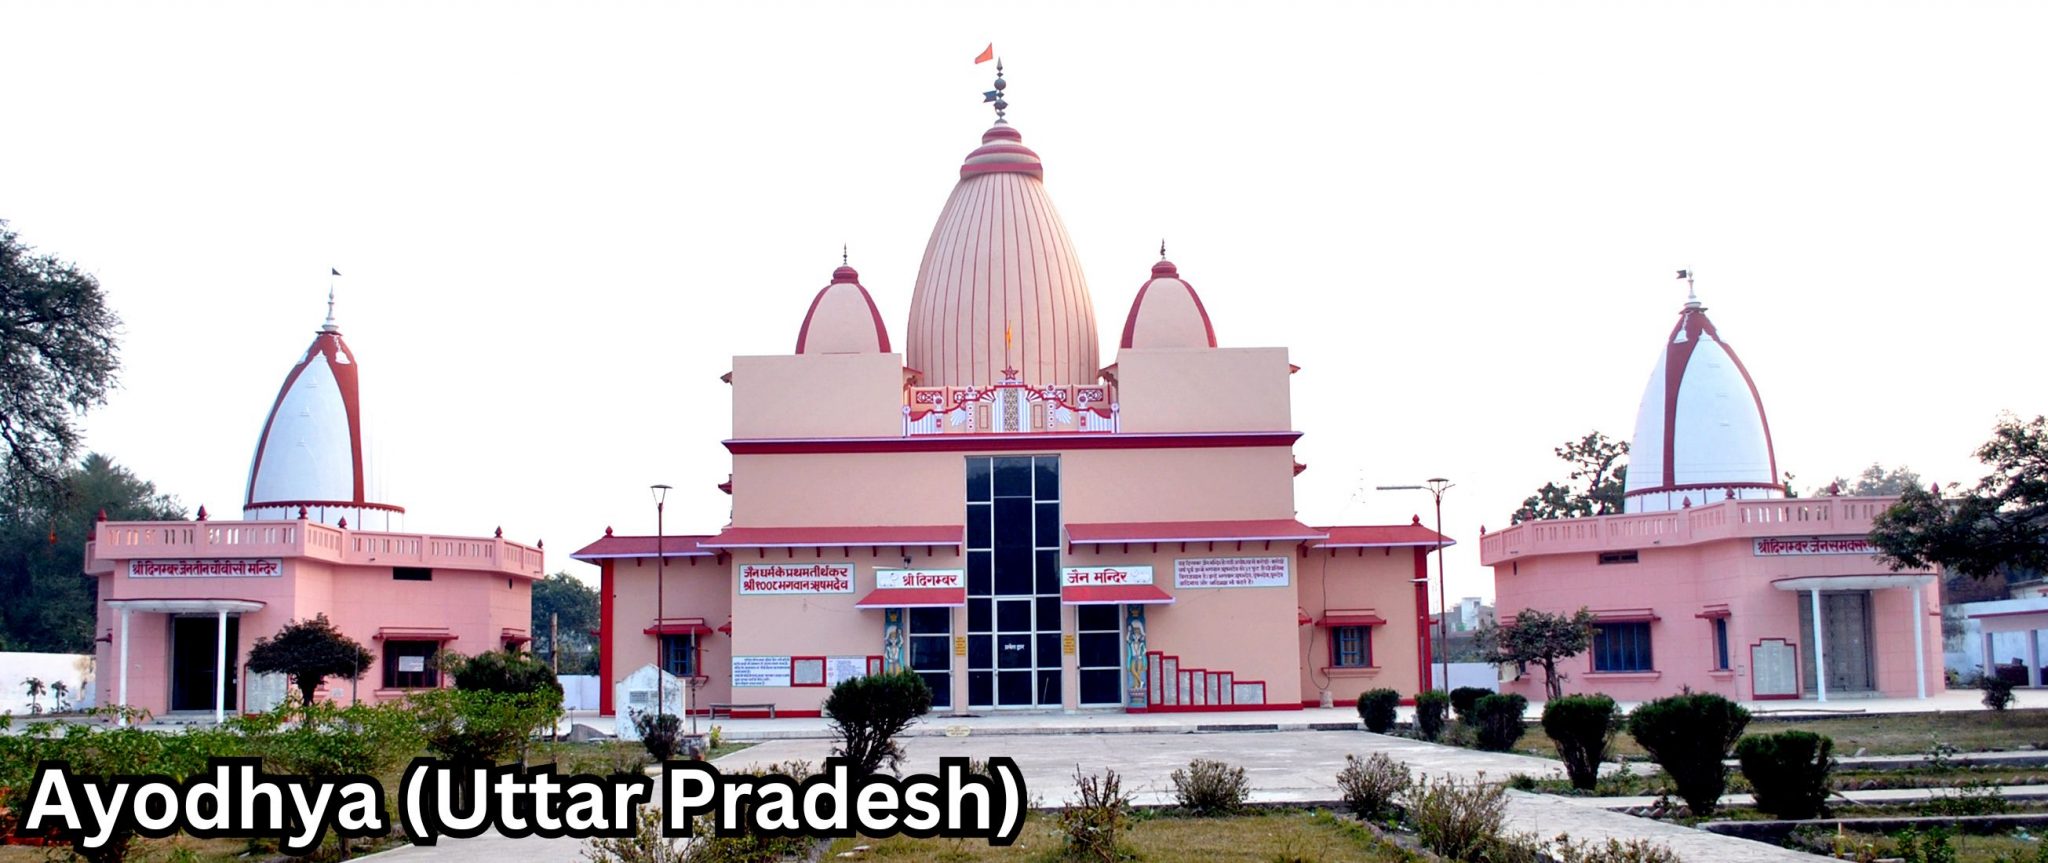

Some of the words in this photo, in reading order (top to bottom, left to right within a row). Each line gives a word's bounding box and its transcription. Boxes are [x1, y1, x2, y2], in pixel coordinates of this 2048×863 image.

[132, 560, 144, 575] श्री
[744, 566, 759, 578] जैन
[760, 566, 775, 578] धर्म
[775, 567, 786, 577] के
[786, 568, 810, 578] प्रथम
[902, 572, 914, 586] श्री
[916, 572, 958, 586] दिगम्बर
[1067, 569, 1089, 583] जैन
[1094, 568, 1128, 583] मन्दिर
[744, 579, 755, 591] श्री
